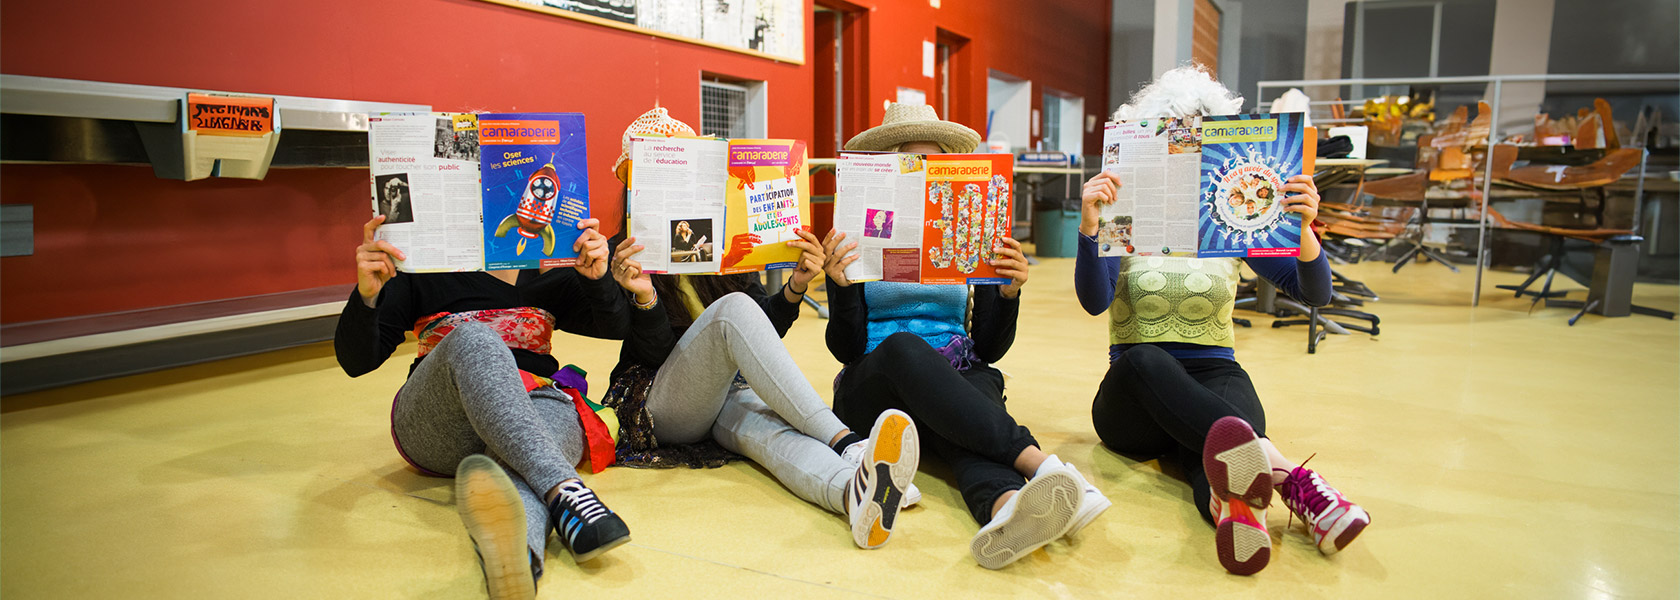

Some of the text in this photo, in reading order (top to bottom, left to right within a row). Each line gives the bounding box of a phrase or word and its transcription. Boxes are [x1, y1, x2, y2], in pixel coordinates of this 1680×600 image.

[504, 151, 522, 159] Oser
[750, 188, 794, 204] PARTICIPATION
[754, 215, 798, 232] ADOLESCENTS
